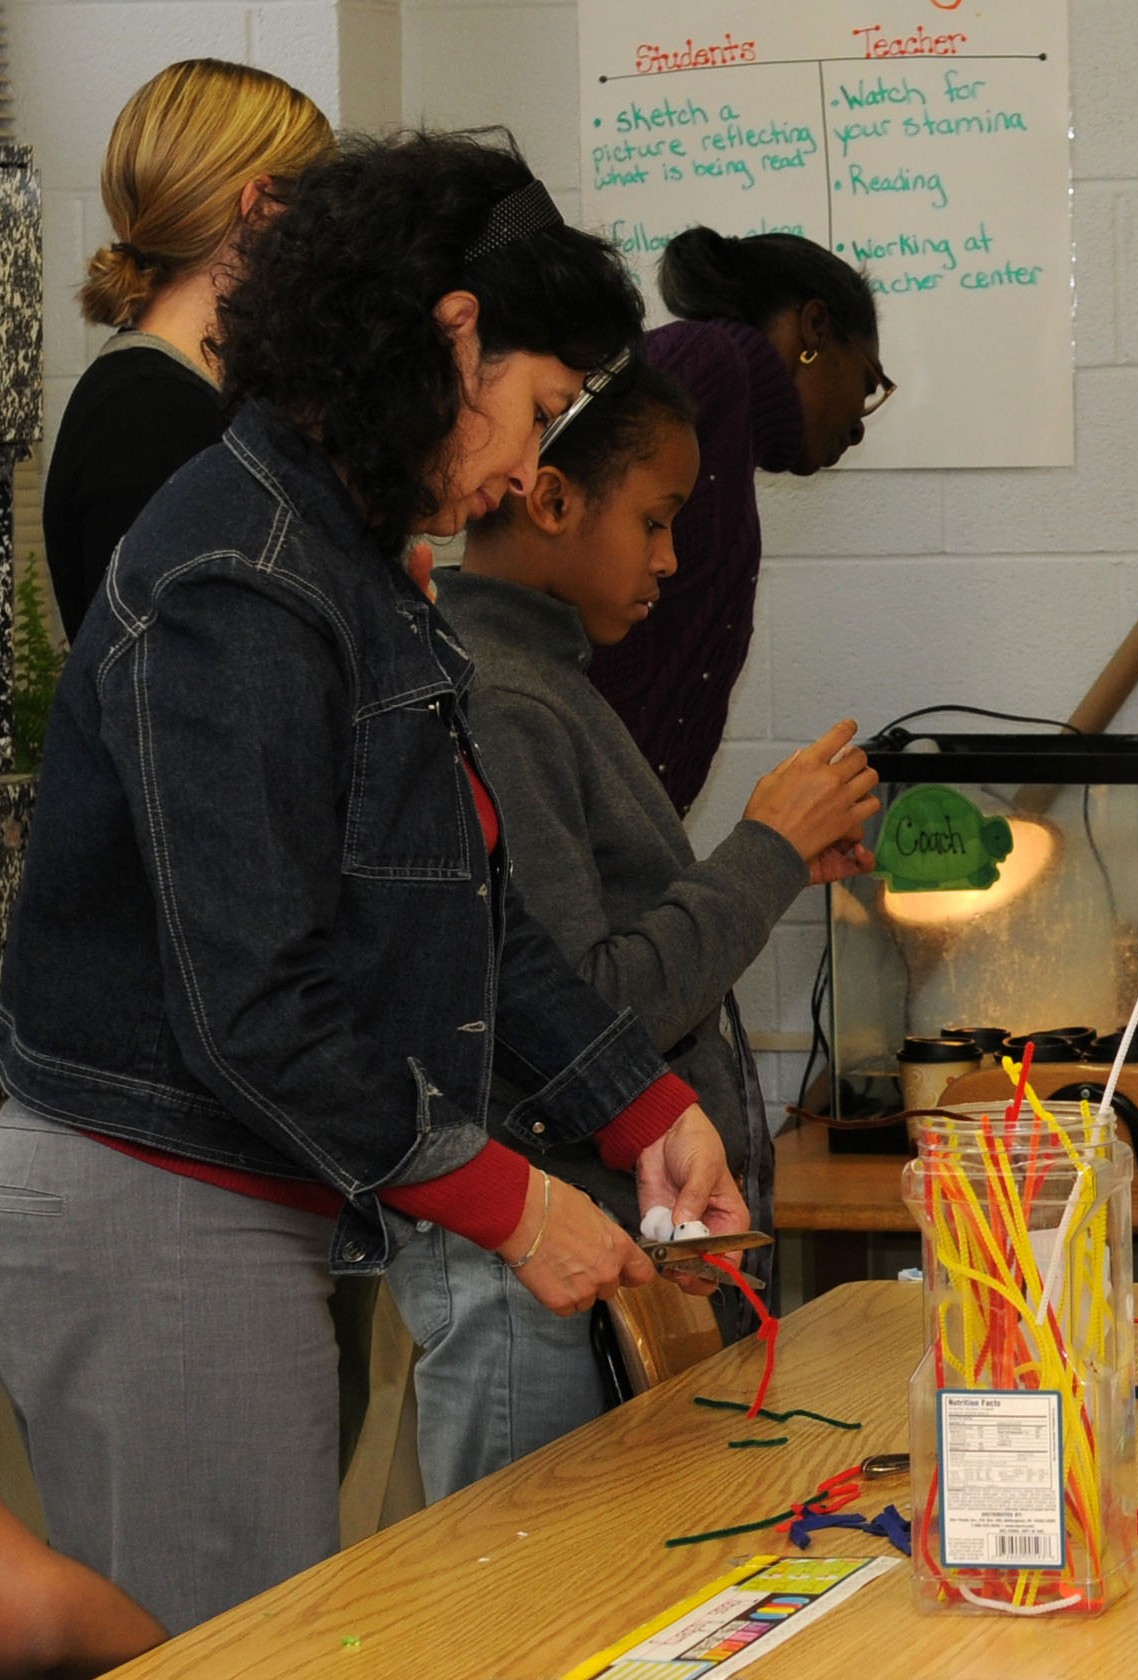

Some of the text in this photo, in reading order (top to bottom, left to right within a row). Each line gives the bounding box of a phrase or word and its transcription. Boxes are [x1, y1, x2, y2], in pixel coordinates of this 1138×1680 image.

[635, 33, 757, 75] Students
[852, 25, 968, 60] Teacher
[839, 69, 986, 110] Watch for
[719, 104, 740, 121] a
[833, 108, 1028, 158] your stamina
[592, 120, 818, 173] picture reflecting
[662, 163, 684, 181] is
[692, 158, 756, 190] being
[761, 151, 806, 170] read
[848, 164, 949, 209] Reading
[852, 221, 994, 270] Working at
[867, 261, 1044, 294] acher center
[896, 815, 966, 856] Coach
